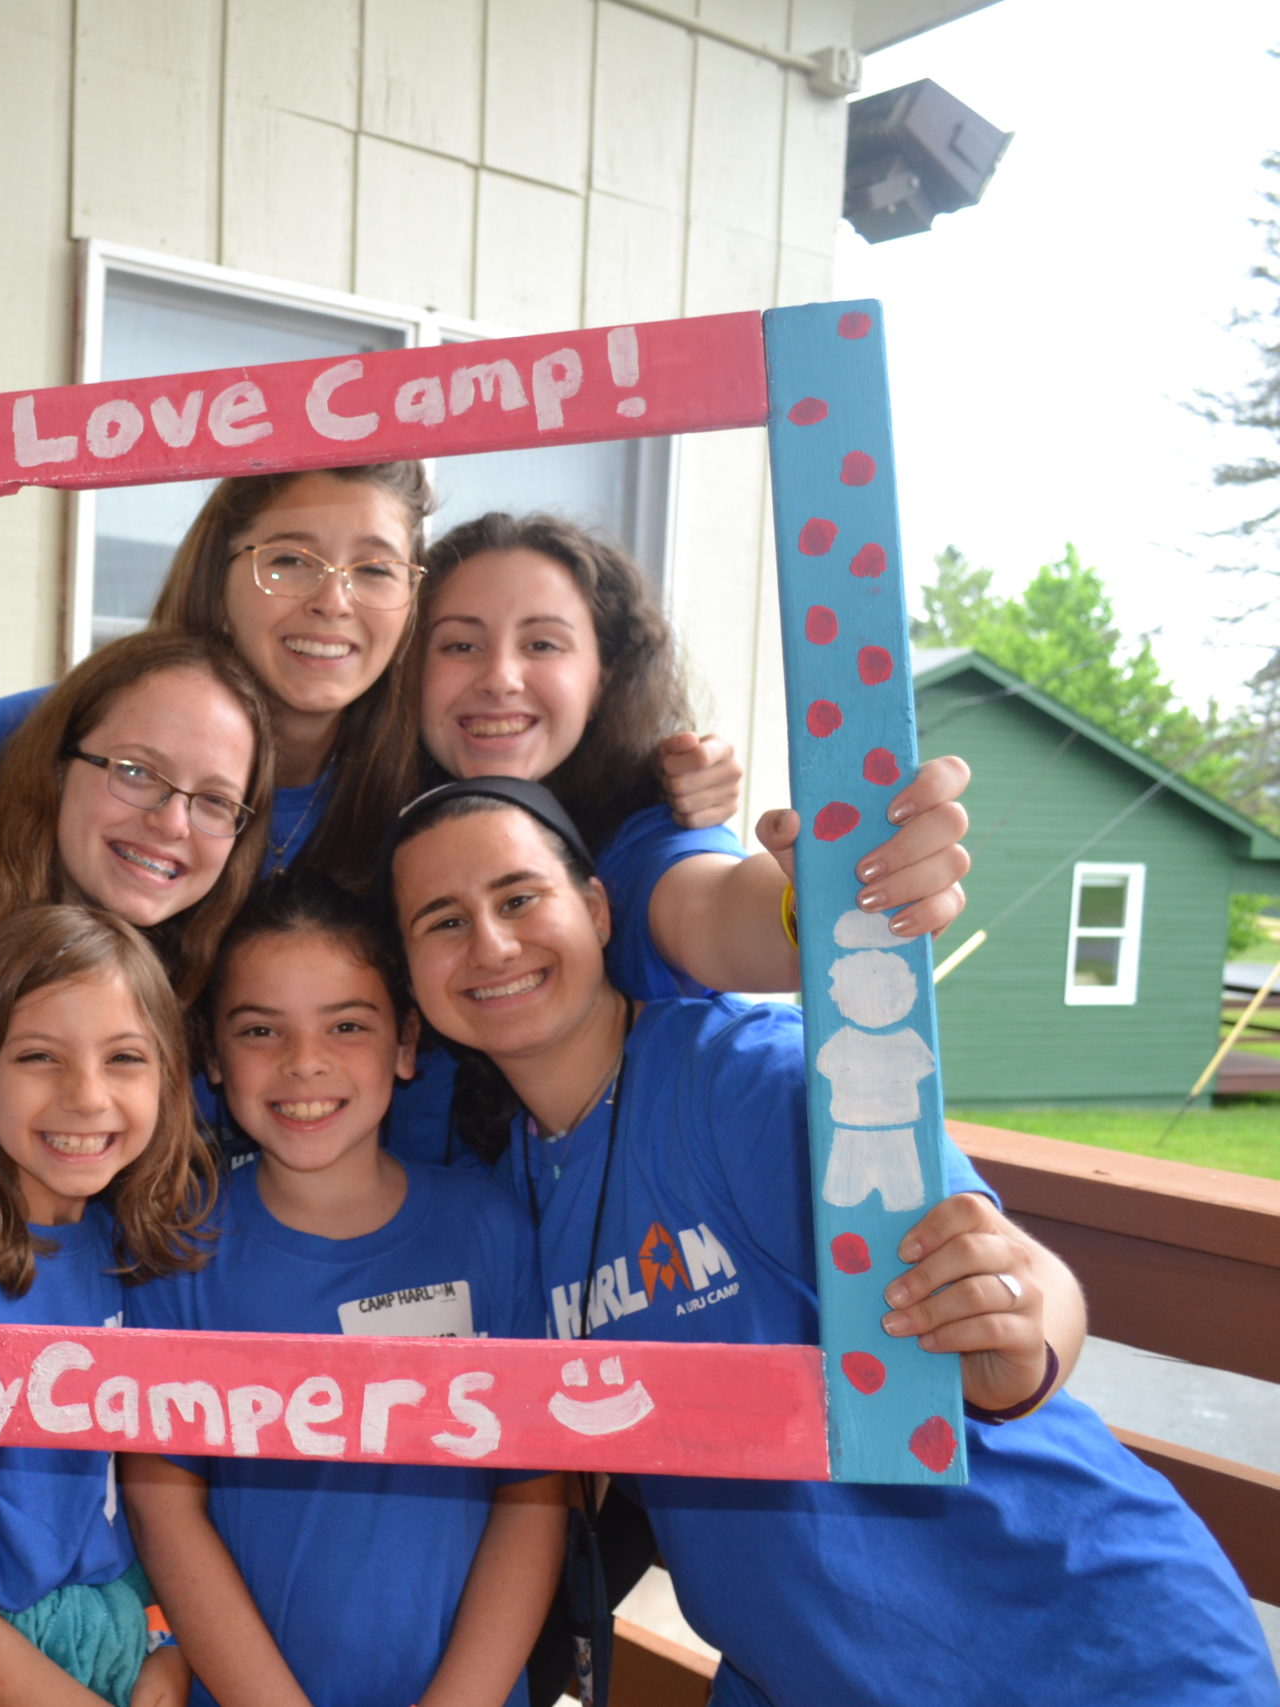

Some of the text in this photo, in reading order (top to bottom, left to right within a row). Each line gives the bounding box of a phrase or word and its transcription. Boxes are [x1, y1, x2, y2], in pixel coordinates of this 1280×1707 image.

[11, 380, 273, 468] Love
[305, 325, 648, 443] Camp!
[358, 1294, 396, 1314] CAMP
[686, 1296, 707, 1313] URJ
[707, 1283, 740, 1305] CAMP
